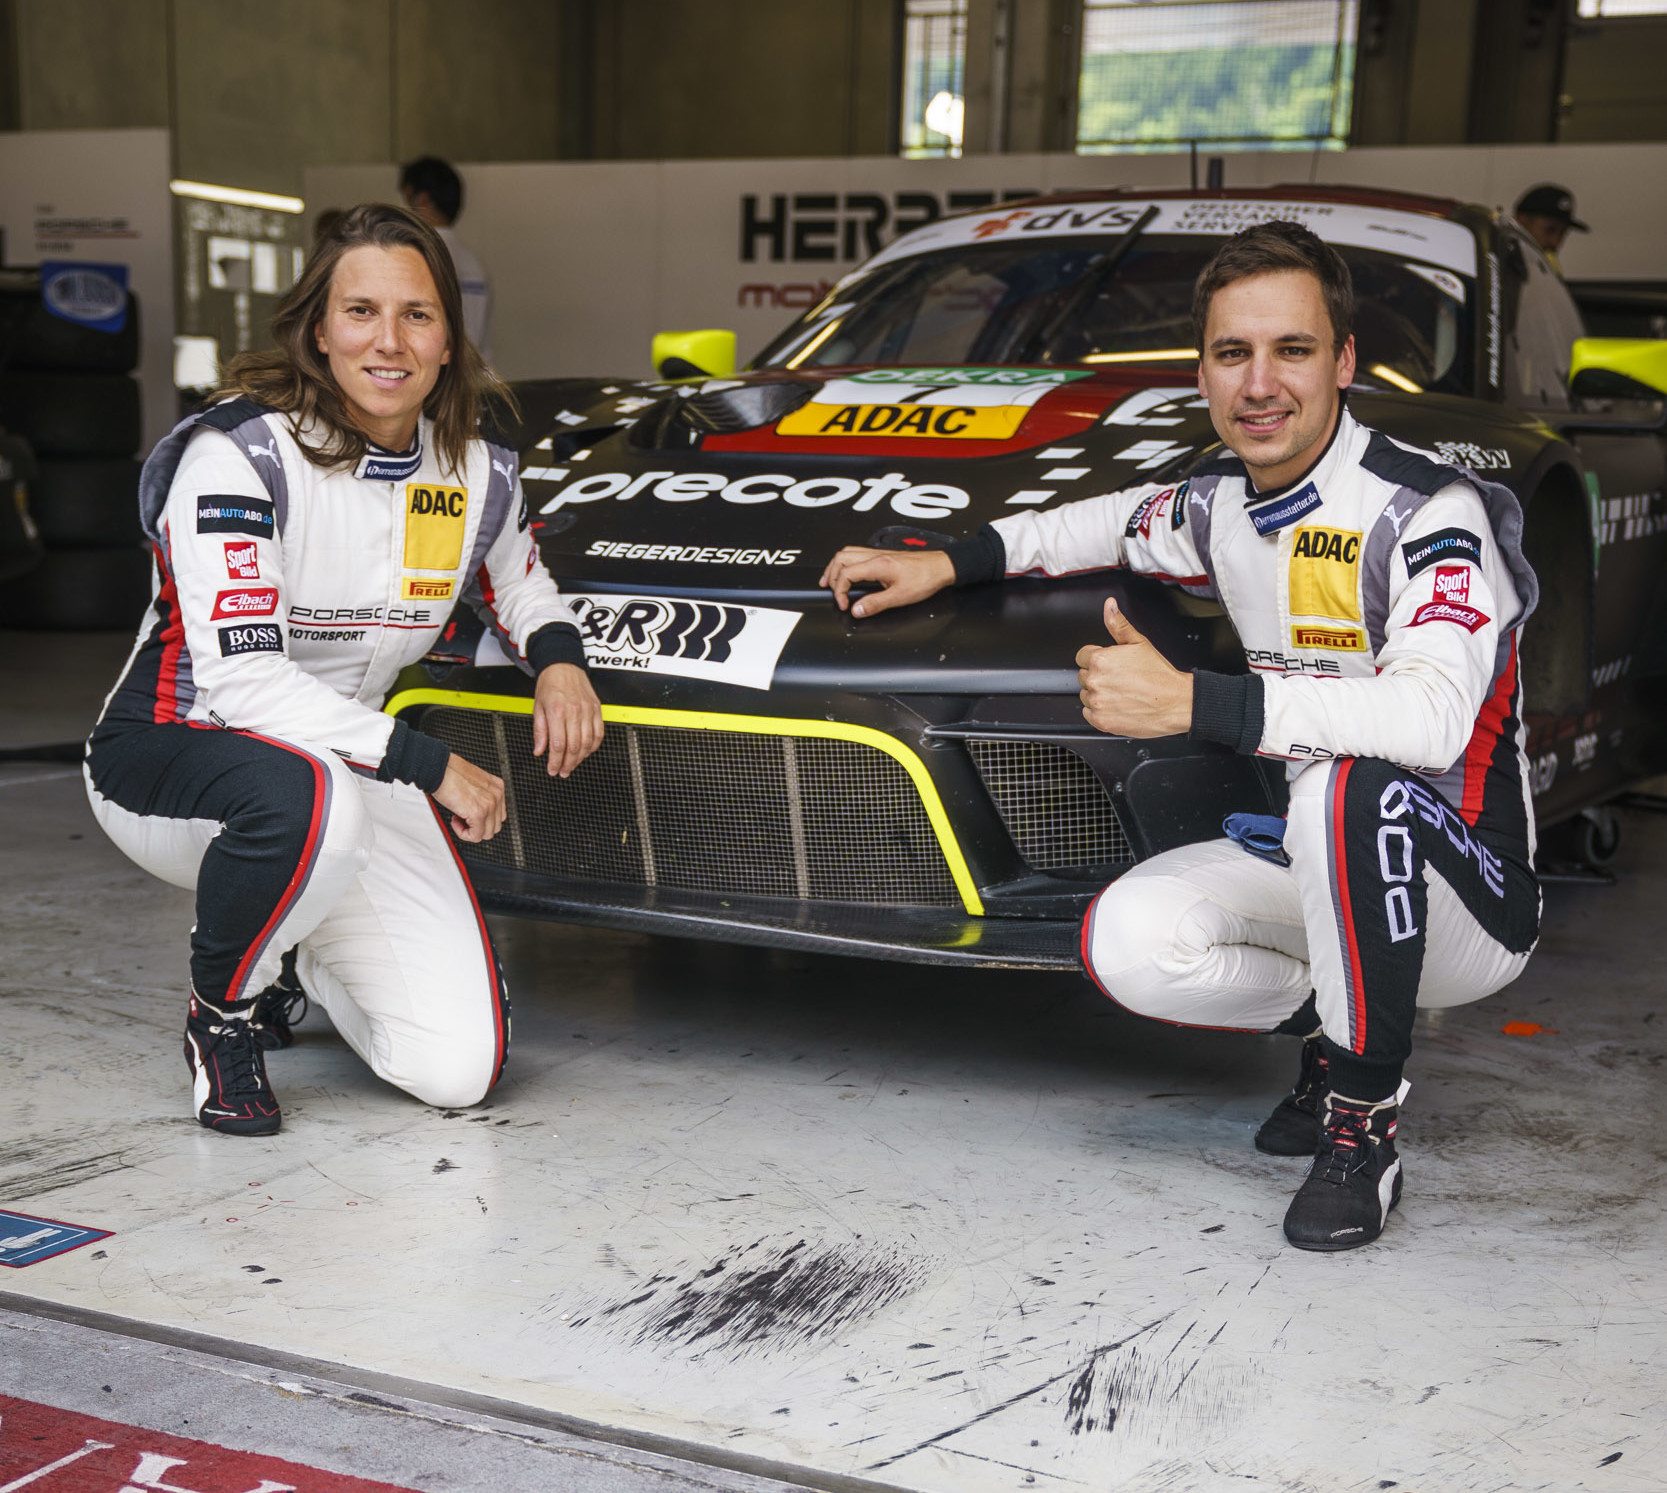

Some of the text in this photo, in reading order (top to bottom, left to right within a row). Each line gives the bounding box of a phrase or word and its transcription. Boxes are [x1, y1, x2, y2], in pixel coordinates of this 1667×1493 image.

[1189, 202, 1335, 216] DEUTSCHER
[1023, 207, 1141, 231] dvs
[857, 369, 1067, 383] DEKRA
[900, 385, 958, 404] 7
[819, 405, 976, 435] ADAC
[411, 488, 464, 518] ADAC
[538, 472, 970, 518] precote
[198, 507, 273, 525] MEINAUTOABO.de
[226, 544, 257, 570] Sport
[585, 541, 801, 566] SIEGERDESIGNS
[1294, 531, 1359, 564] ADAC
[240, 566, 259, 578] Bild
[1435, 569, 1469, 594] Sport
[219, 593, 274, 612] Eibach
[1446, 592, 1467, 603] Bild
[289, 606, 431, 622] PORSCHE
[228, 627, 278, 646] BOSS
[1296, 629, 1358, 648] PIRELLI
